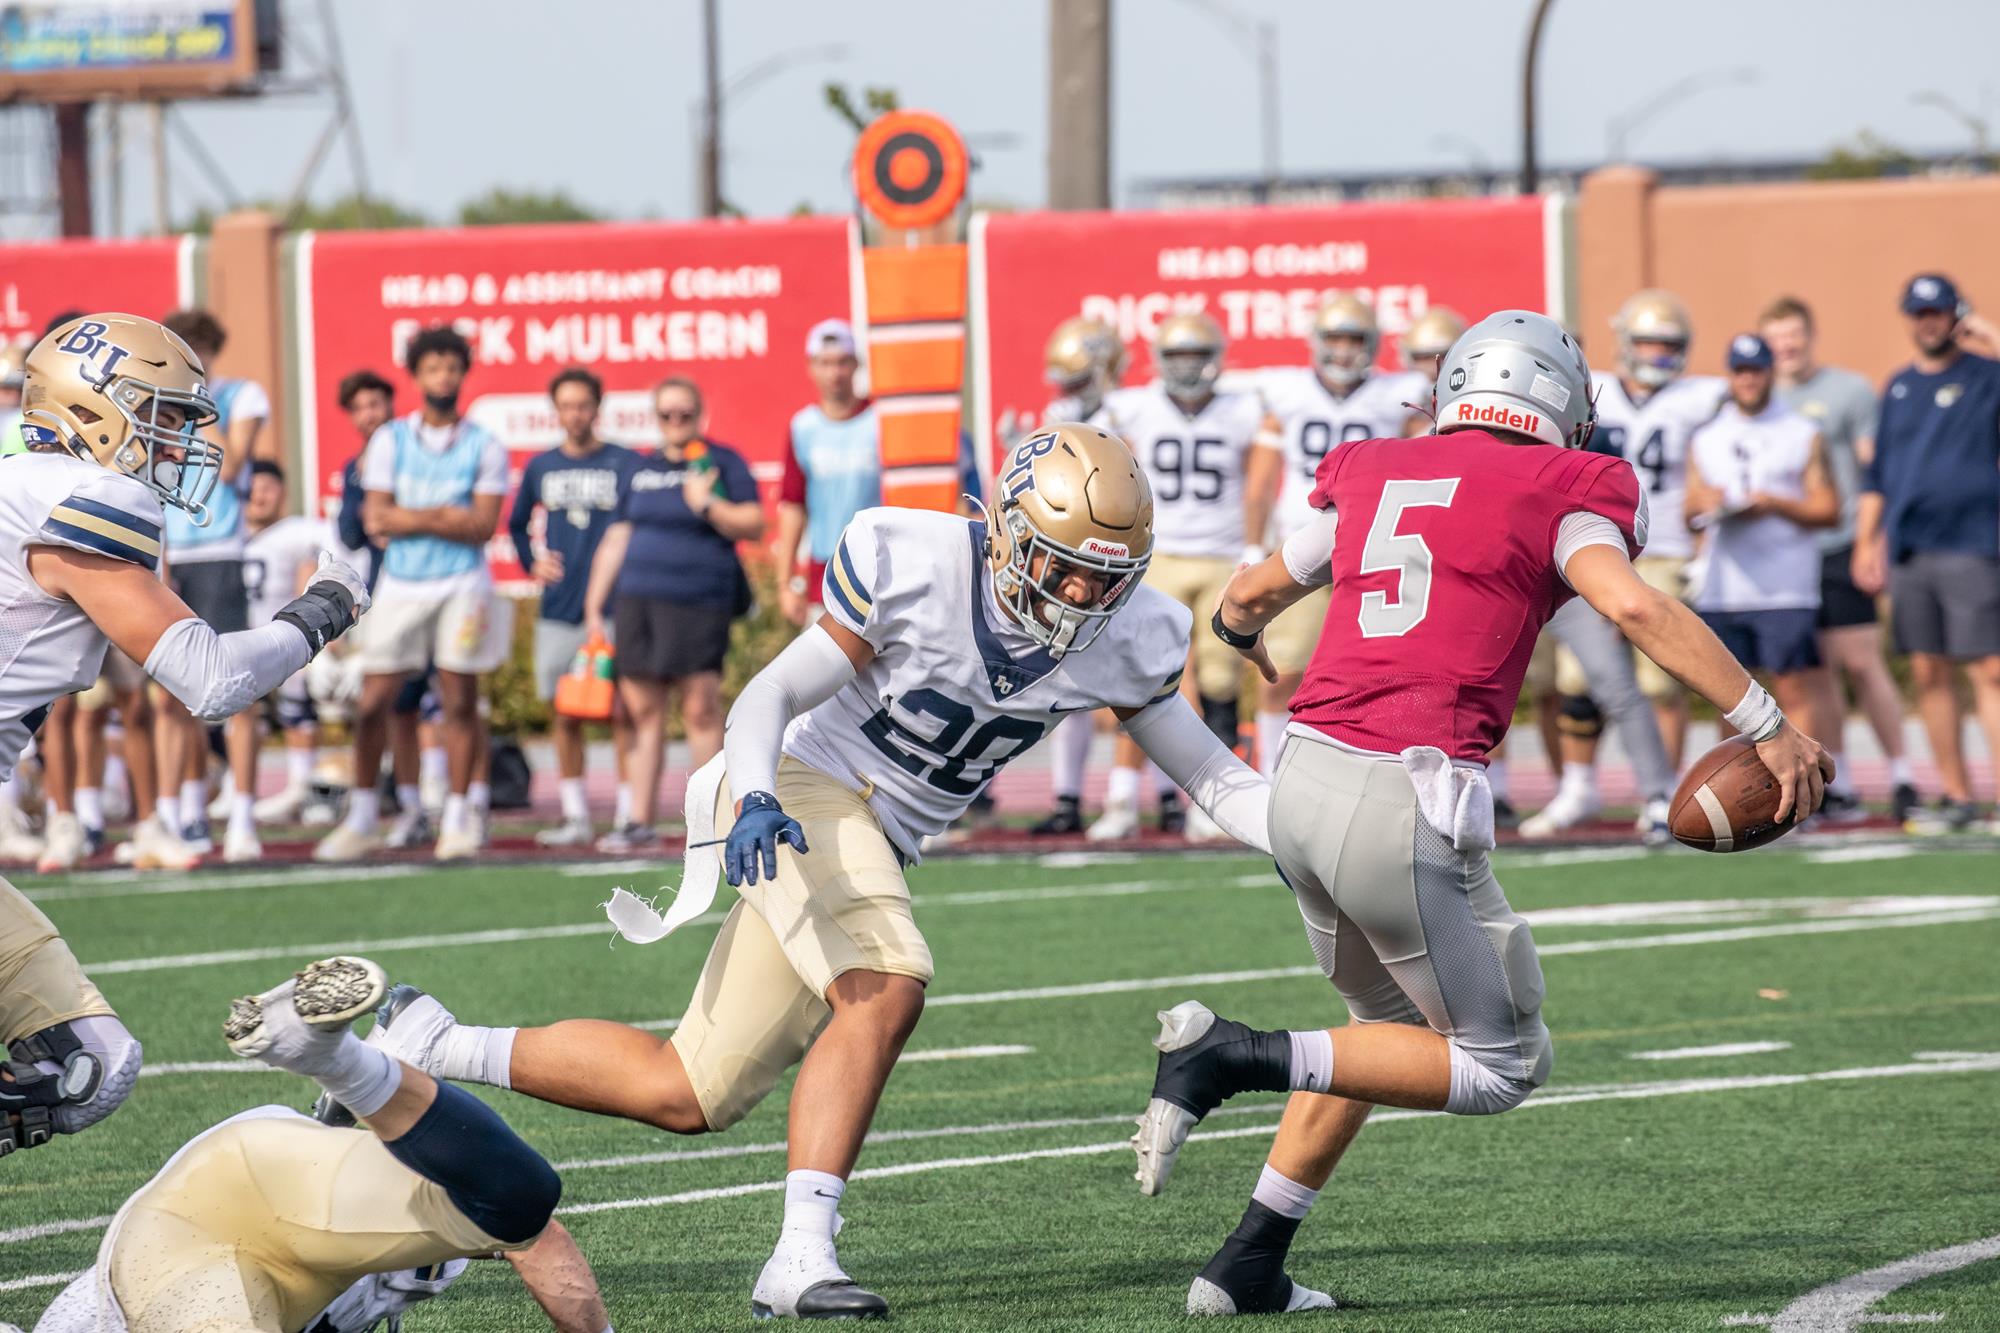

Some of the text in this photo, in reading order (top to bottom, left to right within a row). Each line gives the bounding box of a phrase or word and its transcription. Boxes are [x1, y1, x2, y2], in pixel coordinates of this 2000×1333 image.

[526, 310, 768, 363] MULKERN
[1218, 284, 1429, 340] TREE
[1457, 403, 1540, 434] Riddell
[1153, 437, 1223, 501] 95
[1089, 542, 1127, 557] Riddell
[1358, 477, 1462, 638] 5
[860, 688, 1045, 796] 20
